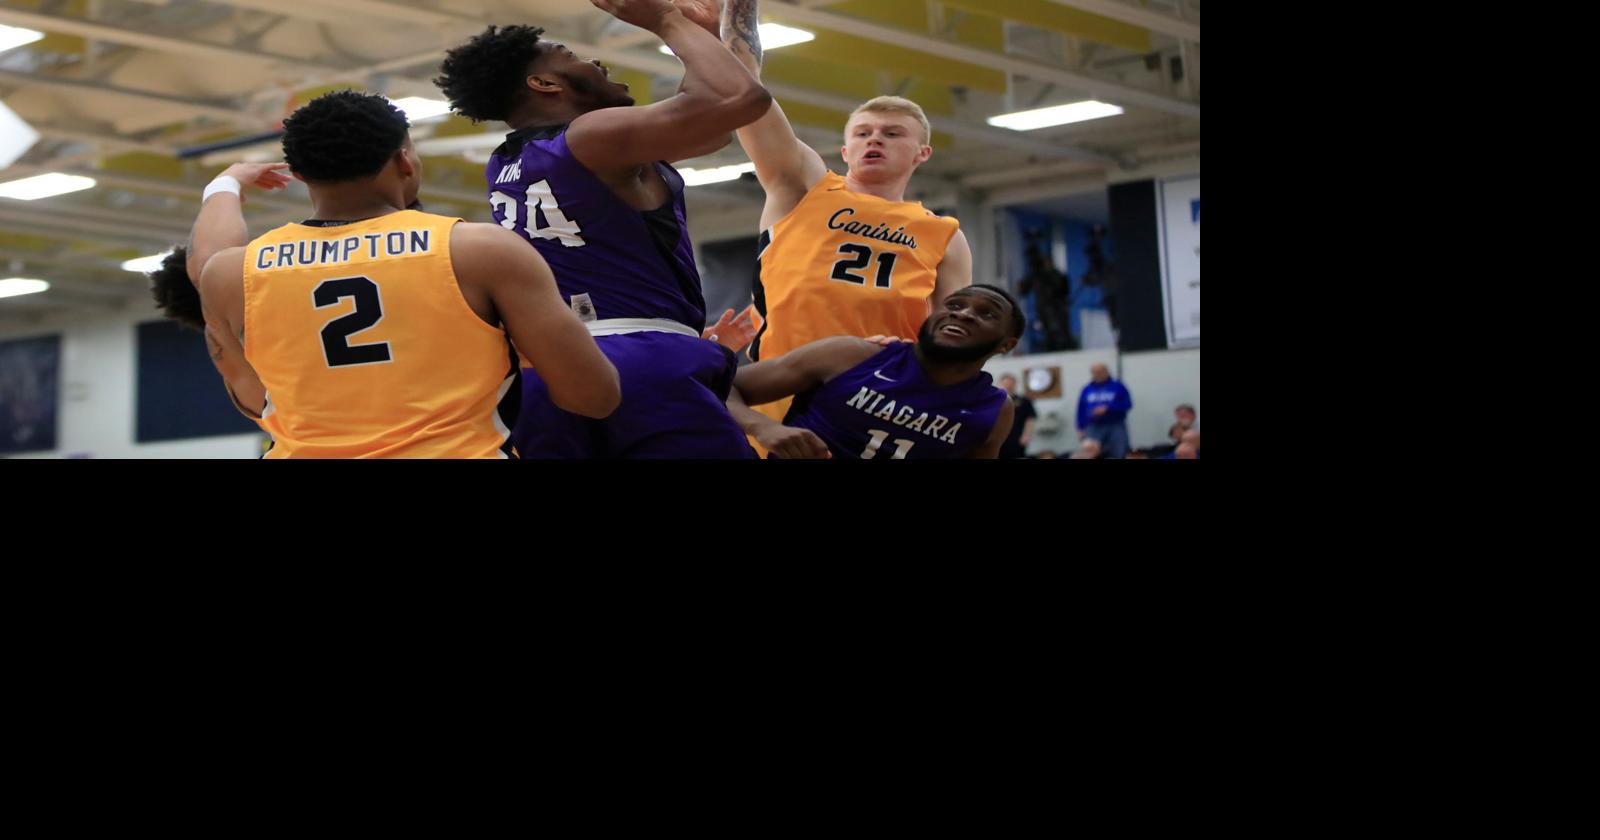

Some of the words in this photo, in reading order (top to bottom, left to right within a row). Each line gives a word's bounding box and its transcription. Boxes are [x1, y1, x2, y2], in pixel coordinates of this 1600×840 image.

[495, 159, 522, 184] KING
[827, 207, 917, 249] Canisius
[256, 230, 430, 270] CRUMPTON
[830, 242, 897, 288] 21
[311, 275, 393, 368] 2
[846, 386, 962, 444] NIAGARA
[860, 428, 915, 459] 11
